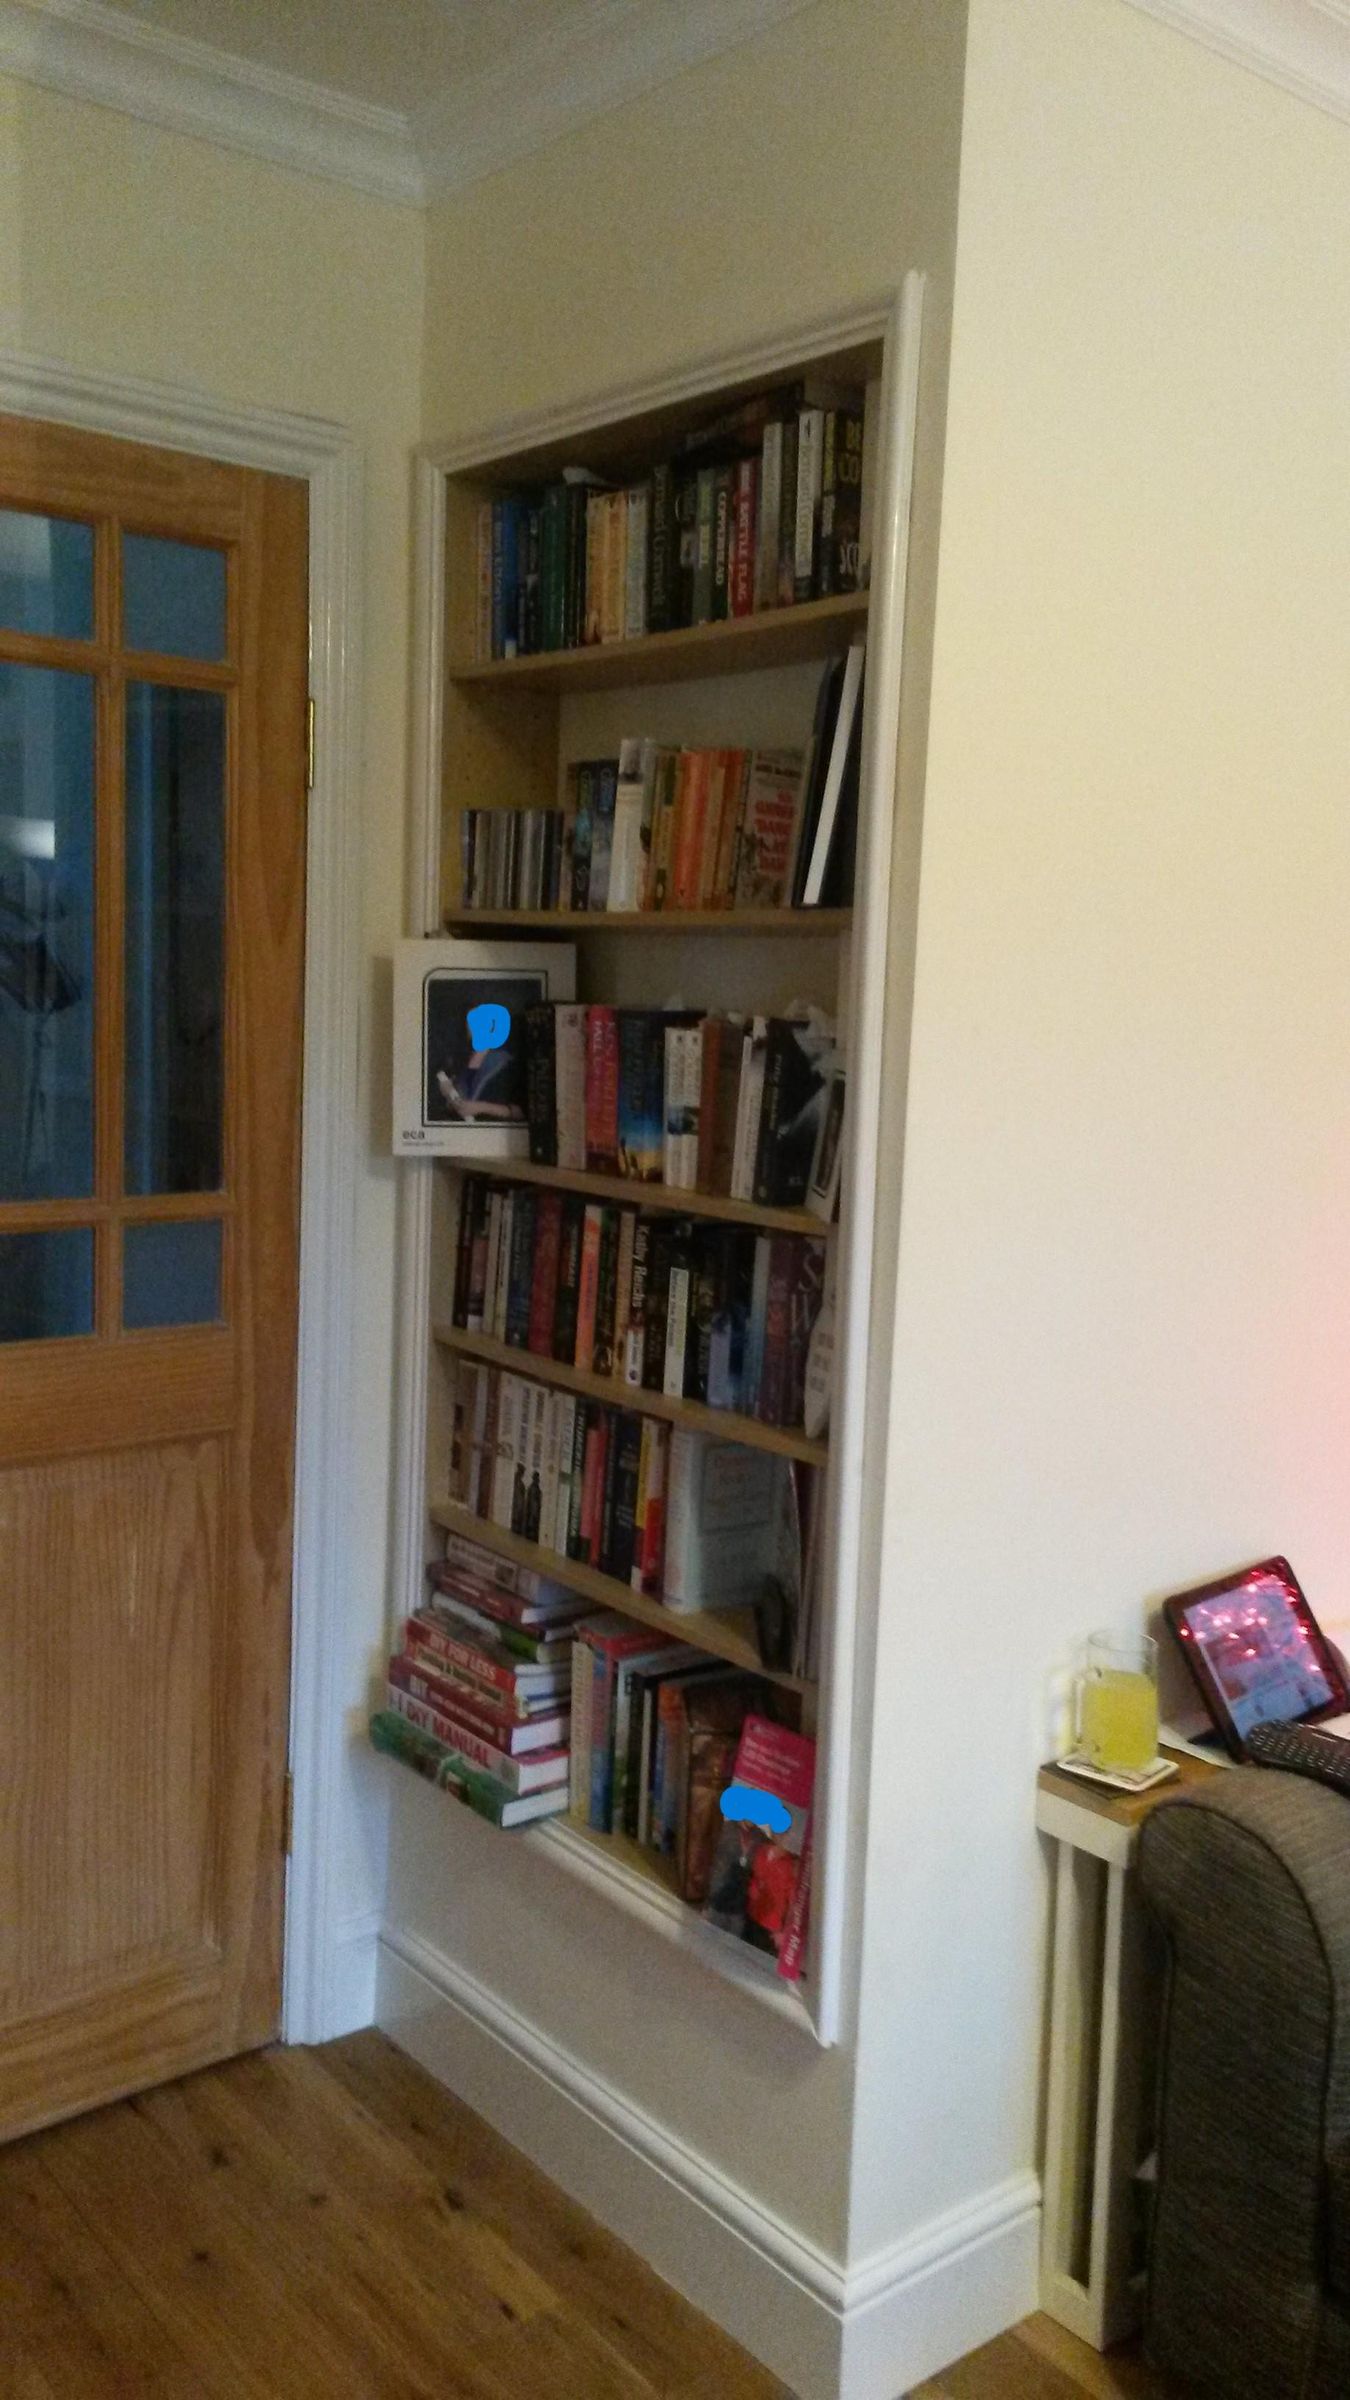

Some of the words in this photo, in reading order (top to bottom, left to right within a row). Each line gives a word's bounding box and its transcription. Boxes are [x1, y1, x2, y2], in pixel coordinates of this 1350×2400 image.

[715, 491, 727, 585] COPPERHEAD
[738, 502, 750, 559] BATTLE
[737, 563, 749, 601] FLAG
[402, 1130, 426, 1140] eca
[632, 1224, 649, 1262] Kathy
[631, 1264, 648, 1309] Reichs
[470, 1654, 497, 1681] LESS
[432, 1715, 491, 1770] MANUAL
[784, 1932, 801, 1966] Map
